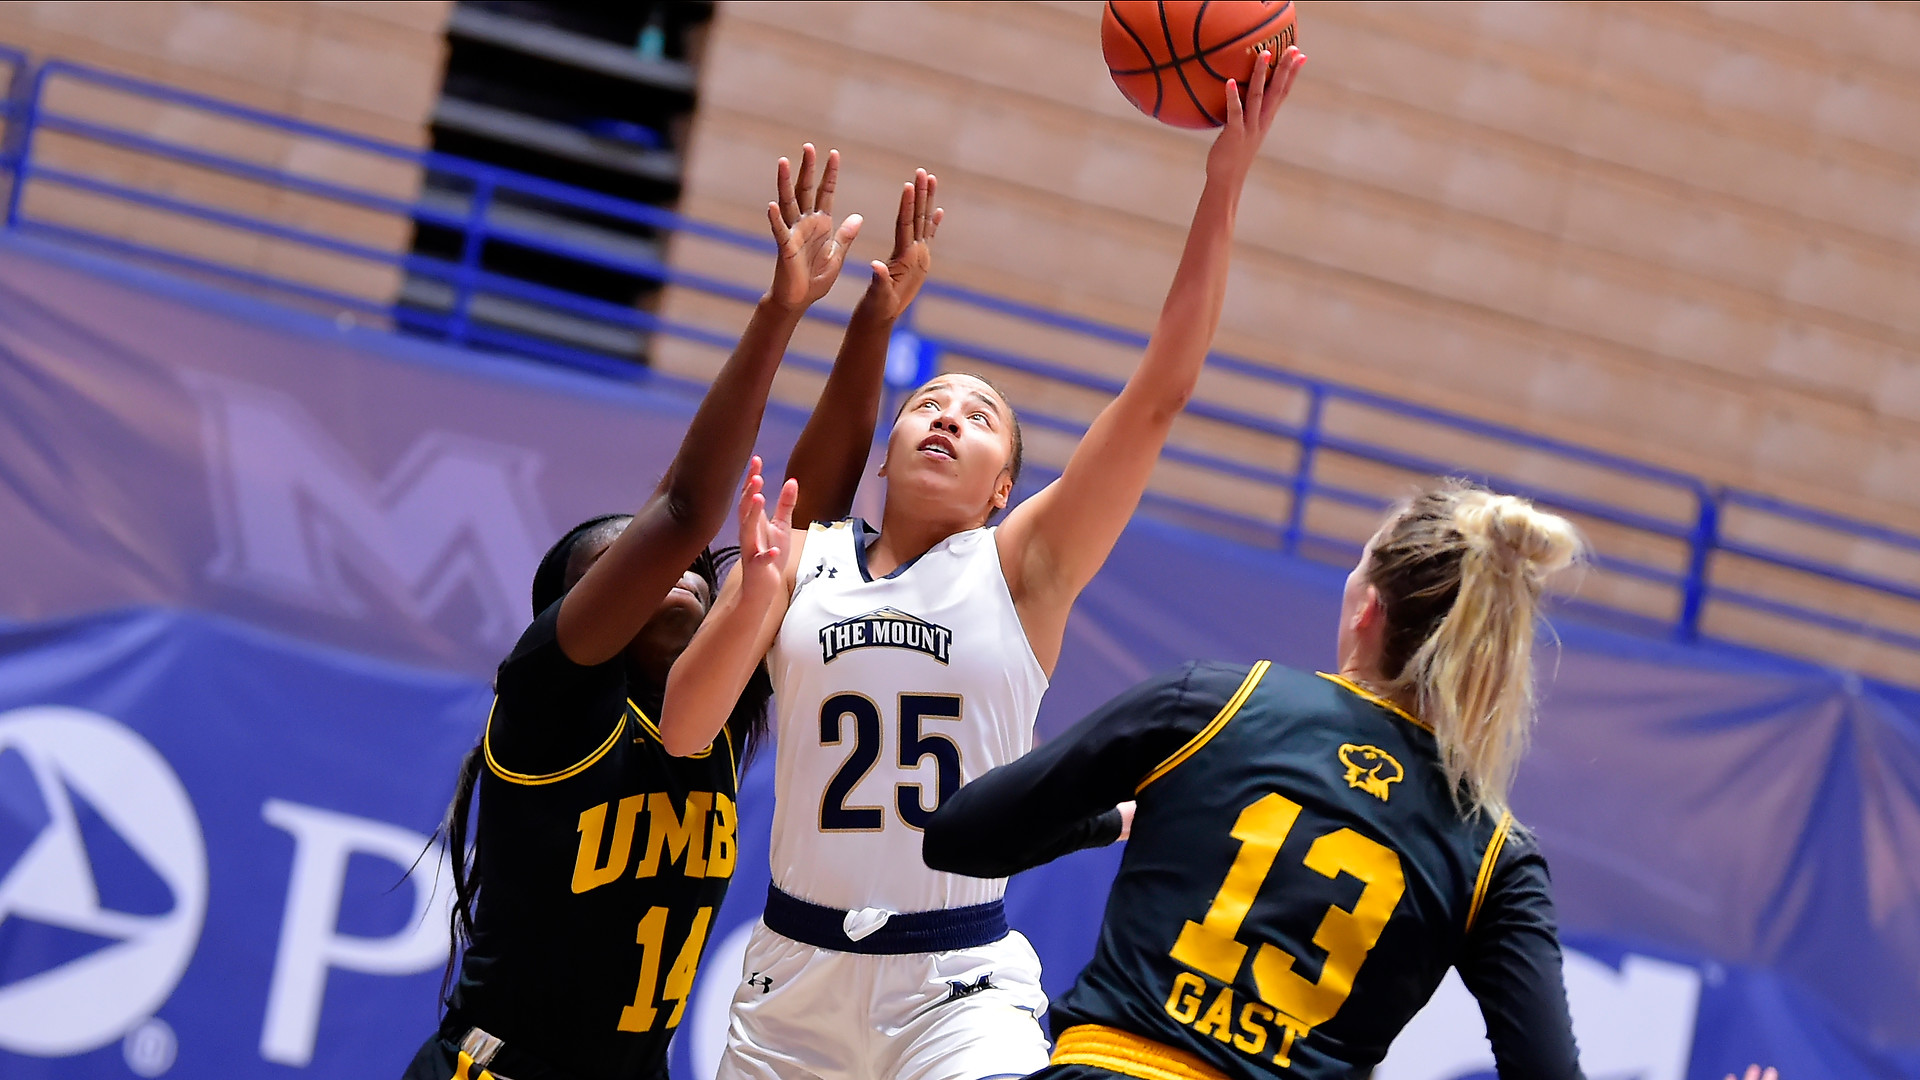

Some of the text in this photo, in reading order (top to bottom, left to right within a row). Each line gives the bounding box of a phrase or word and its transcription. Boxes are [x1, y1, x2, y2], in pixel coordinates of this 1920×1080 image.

[821, 620, 950, 660] THE MOUNT
[818, 690, 964, 833] 25
[571, 790, 738, 894] UMB
[1169, 792, 1406, 1028] 13
[617, 905, 712, 1033] 14
[1164, 972, 1312, 1068] GAST
